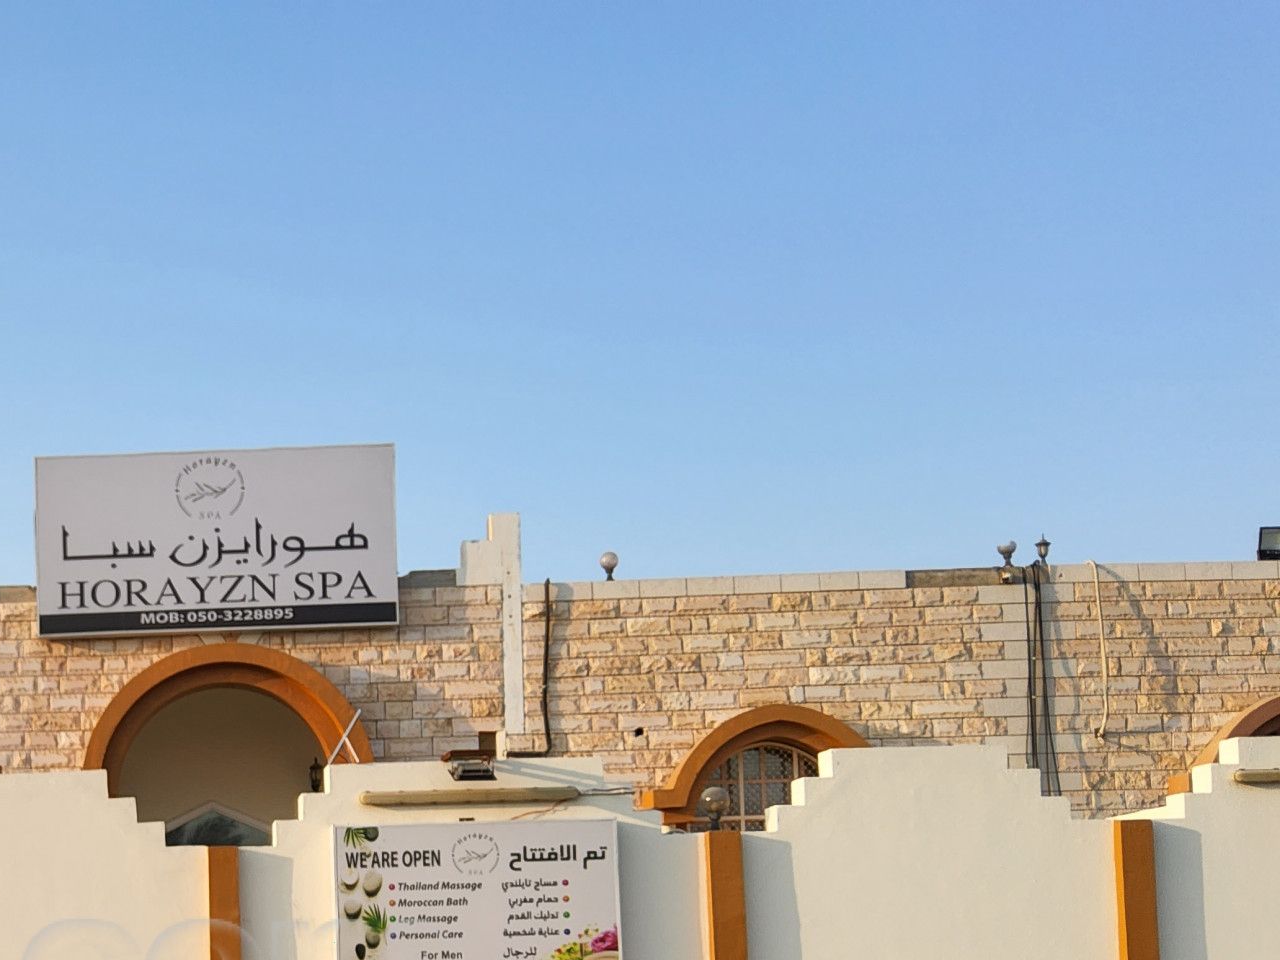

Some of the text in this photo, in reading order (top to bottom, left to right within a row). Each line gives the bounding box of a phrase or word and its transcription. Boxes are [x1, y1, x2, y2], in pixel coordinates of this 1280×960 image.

[61, 524, 157, 569] سبا
[57, 570, 377, 610] HORAYZN SPA
[345, 849, 442, 868] WE ARE OPEN
[509, 844, 608, 872] تم الافتتاح
[398, 881, 483, 891] Thailand Massage
[398, 896, 469, 907] Moroccan Bath
[398, 914, 459, 925] Leg Massage
[399, 930, 464, 940] Personal Care
[421, 950, 463, 960] For Men
